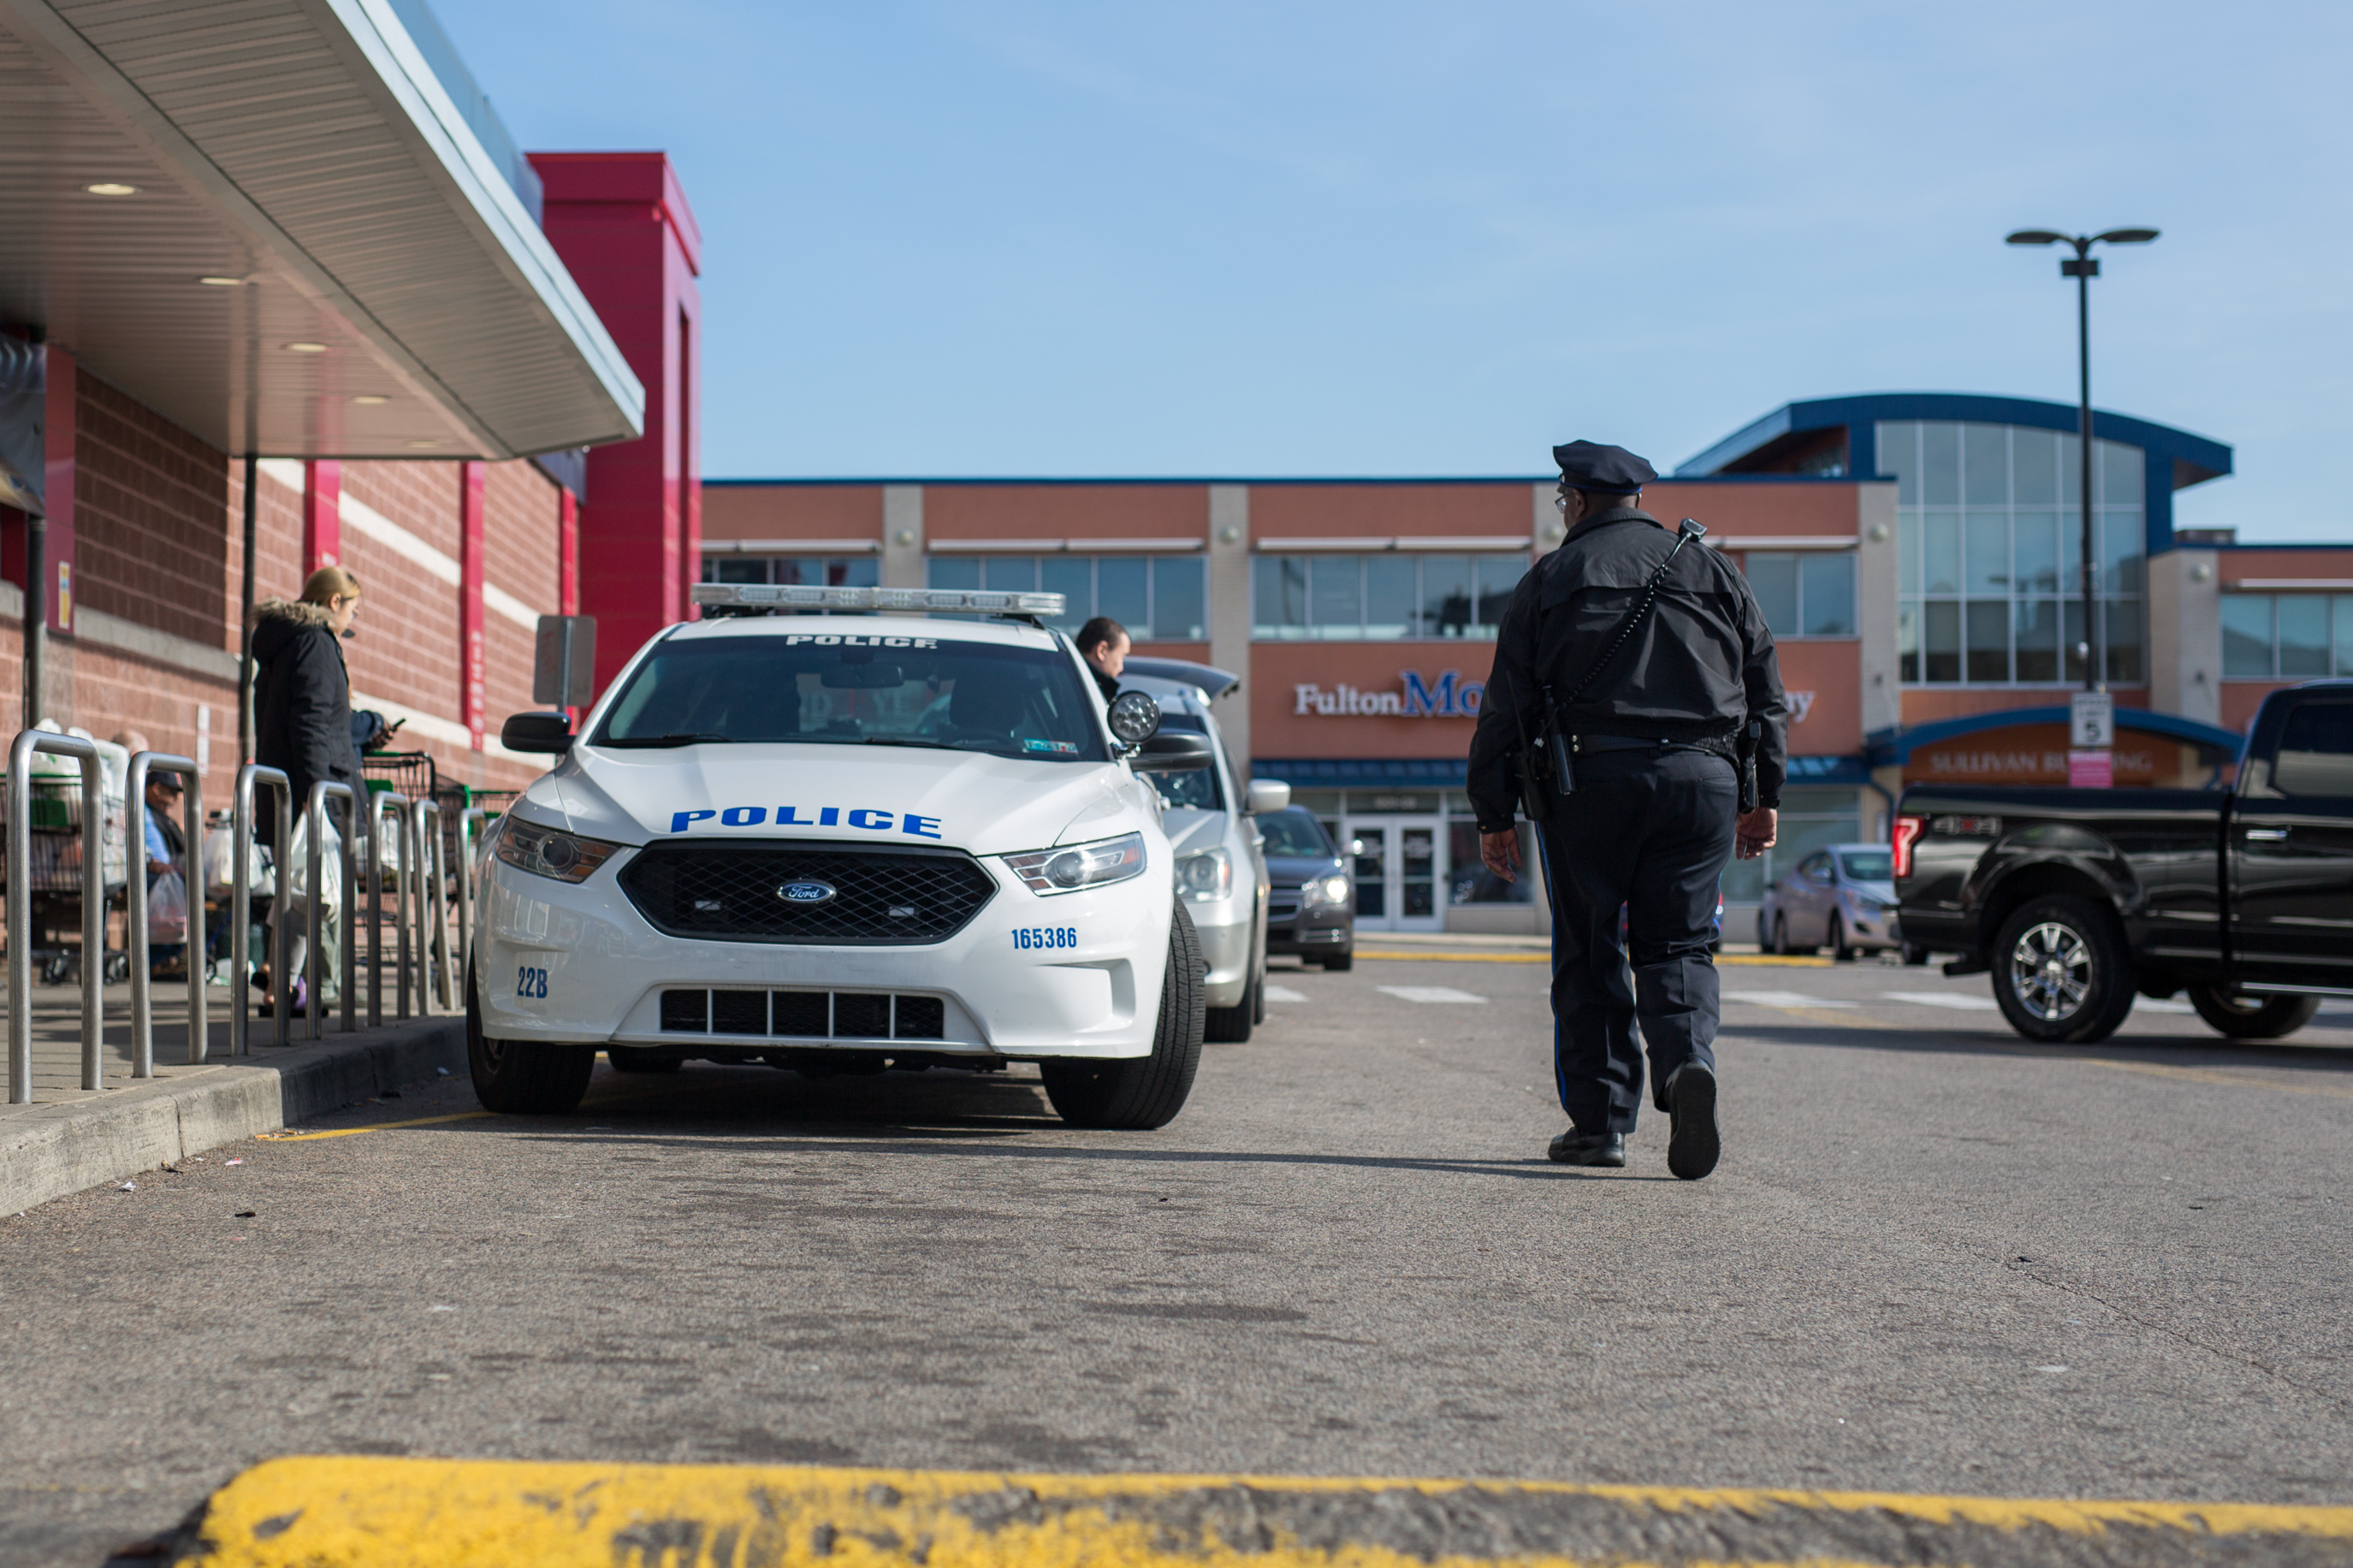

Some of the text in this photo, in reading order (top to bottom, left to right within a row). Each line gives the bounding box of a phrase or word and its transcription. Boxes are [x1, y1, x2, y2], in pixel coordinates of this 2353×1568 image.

[785, 635, 938, 649] POLICE
[1294, 683, 1402, 715] Fulton
[2084, 719, 2101, 743] 5
[1930, 752, 2039, 772] SULLIVAN
[2042, 752, 2154, 772] BUING
[671, 807, 941, 839] POLICE
[787, 886, 820, 900] Ford
[1011, 927, 1076, 950] 165386
[517, 966, 548, 999] 22B
